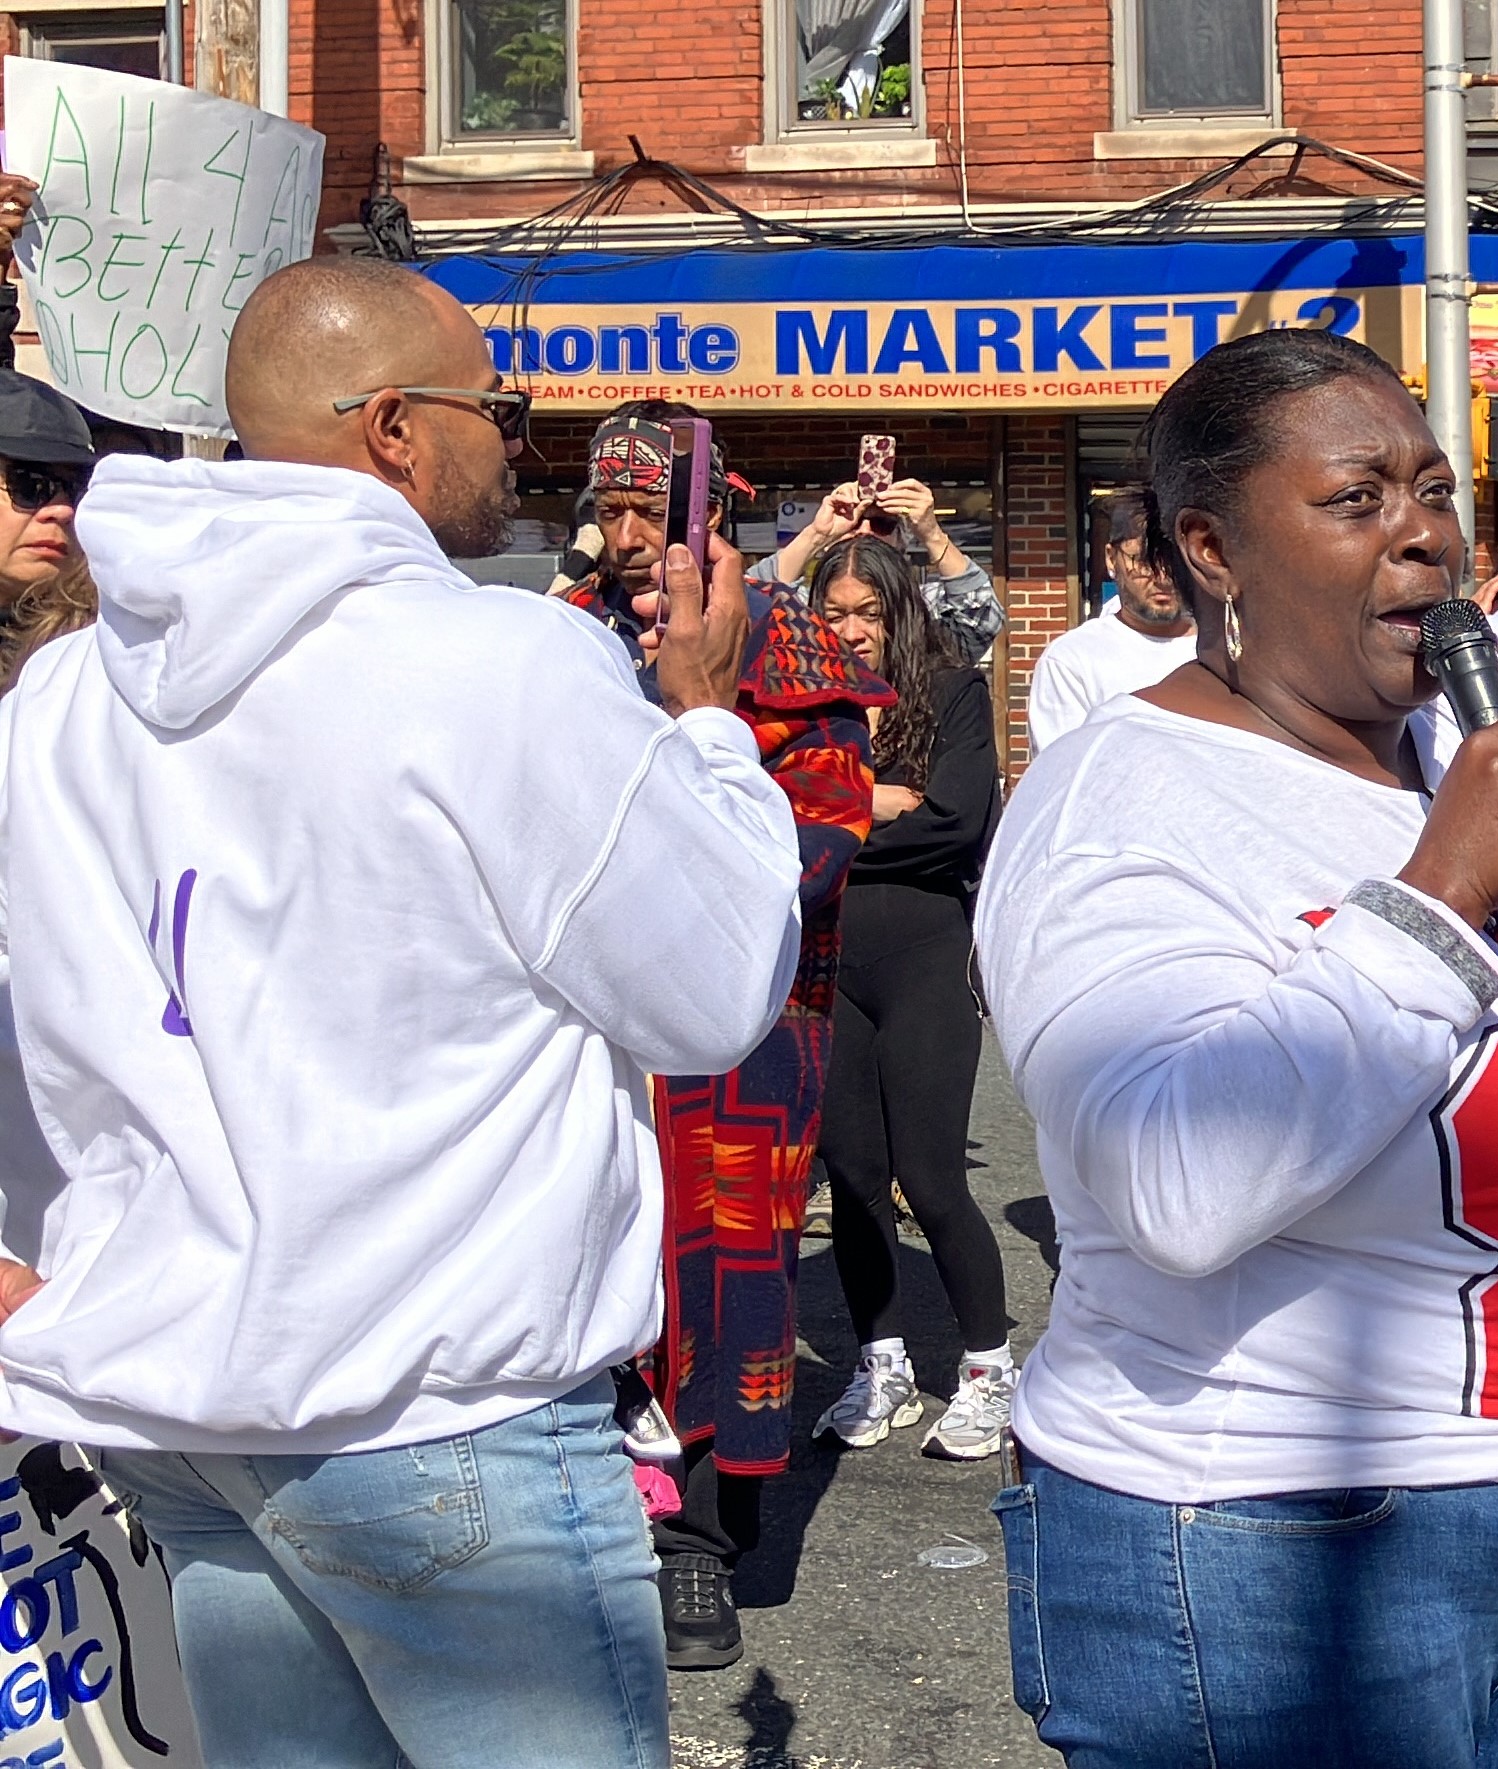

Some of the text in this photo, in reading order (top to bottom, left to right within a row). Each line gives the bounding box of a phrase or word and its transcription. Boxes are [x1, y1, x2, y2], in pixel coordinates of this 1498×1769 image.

[39, 85, 153, 225] All
[203, 119, 254, 248] 4
[69, 309, 230, 407] HOL
[480, 310, 741, 376] monte
[774, 299, 1238, 375] MARKET
[587, 385, 672, 400] COFFEE
[684, 385, 727, 398] TEA
[739, 384, 784, 398] HOT
[791, 384, 804, 398] &
[812, 384, 872, 398] COLD
[878, 383, 1027, 398] SANDWICHES
[1042, 379, 1168, 398] CIGARETTE
[0, 1550, 84, 1655] OT
[0, 1637, 113, 1731] GIC
